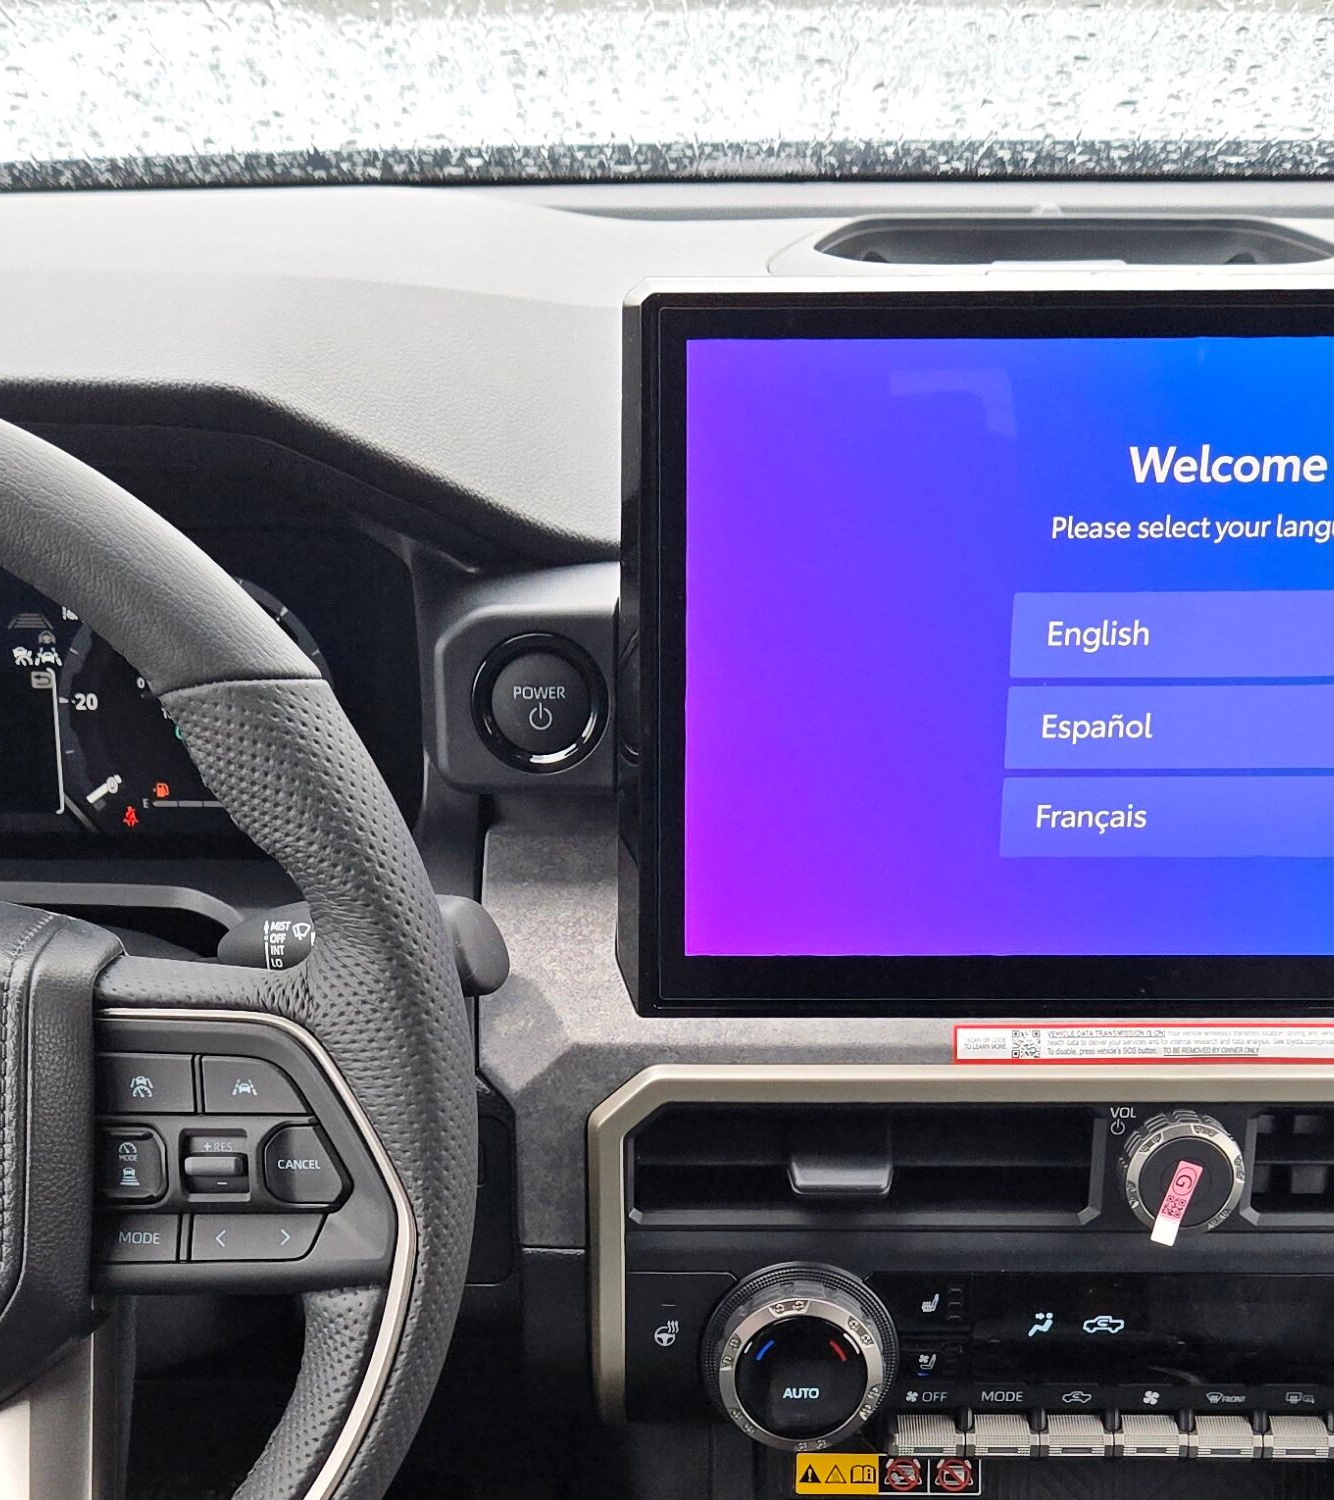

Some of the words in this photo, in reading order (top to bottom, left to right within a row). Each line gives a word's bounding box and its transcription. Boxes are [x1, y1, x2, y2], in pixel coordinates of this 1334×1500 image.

[1128, 444, 1328, 483] Welcome
[1050, 516, 1131, 540] Please
[1136, 515, 1210, 539] select
[1213, 519, 1272, 544] your
[1046, 620, 1151, 653] English
[513, 686, 566, 700] POWER
[75, 693, 98, 711] 20
[1041, 713, 1153, 745] Español
[1035, 803, 1147, 834] Français
[270, 920, 292, 931] MIST
[270, 934, 286, 943] OFF
[270, 945, 285, 956] INT
[270, 958, 284, 969] LO
[1122, 1047, 1136, 1055] SOS
[1110, 1107, 1136, 1118] VOL
[118, 1154, 138, 1162] MODE
[277, 1159, 321, 1170] CANCEL
[118, 1231, 160, 1245] MODE
[782, 1387, 820, 1399] AUTO
[922, 1391, 948, 1402] OFF
[981, 1391, 1024, 1401] MODE
